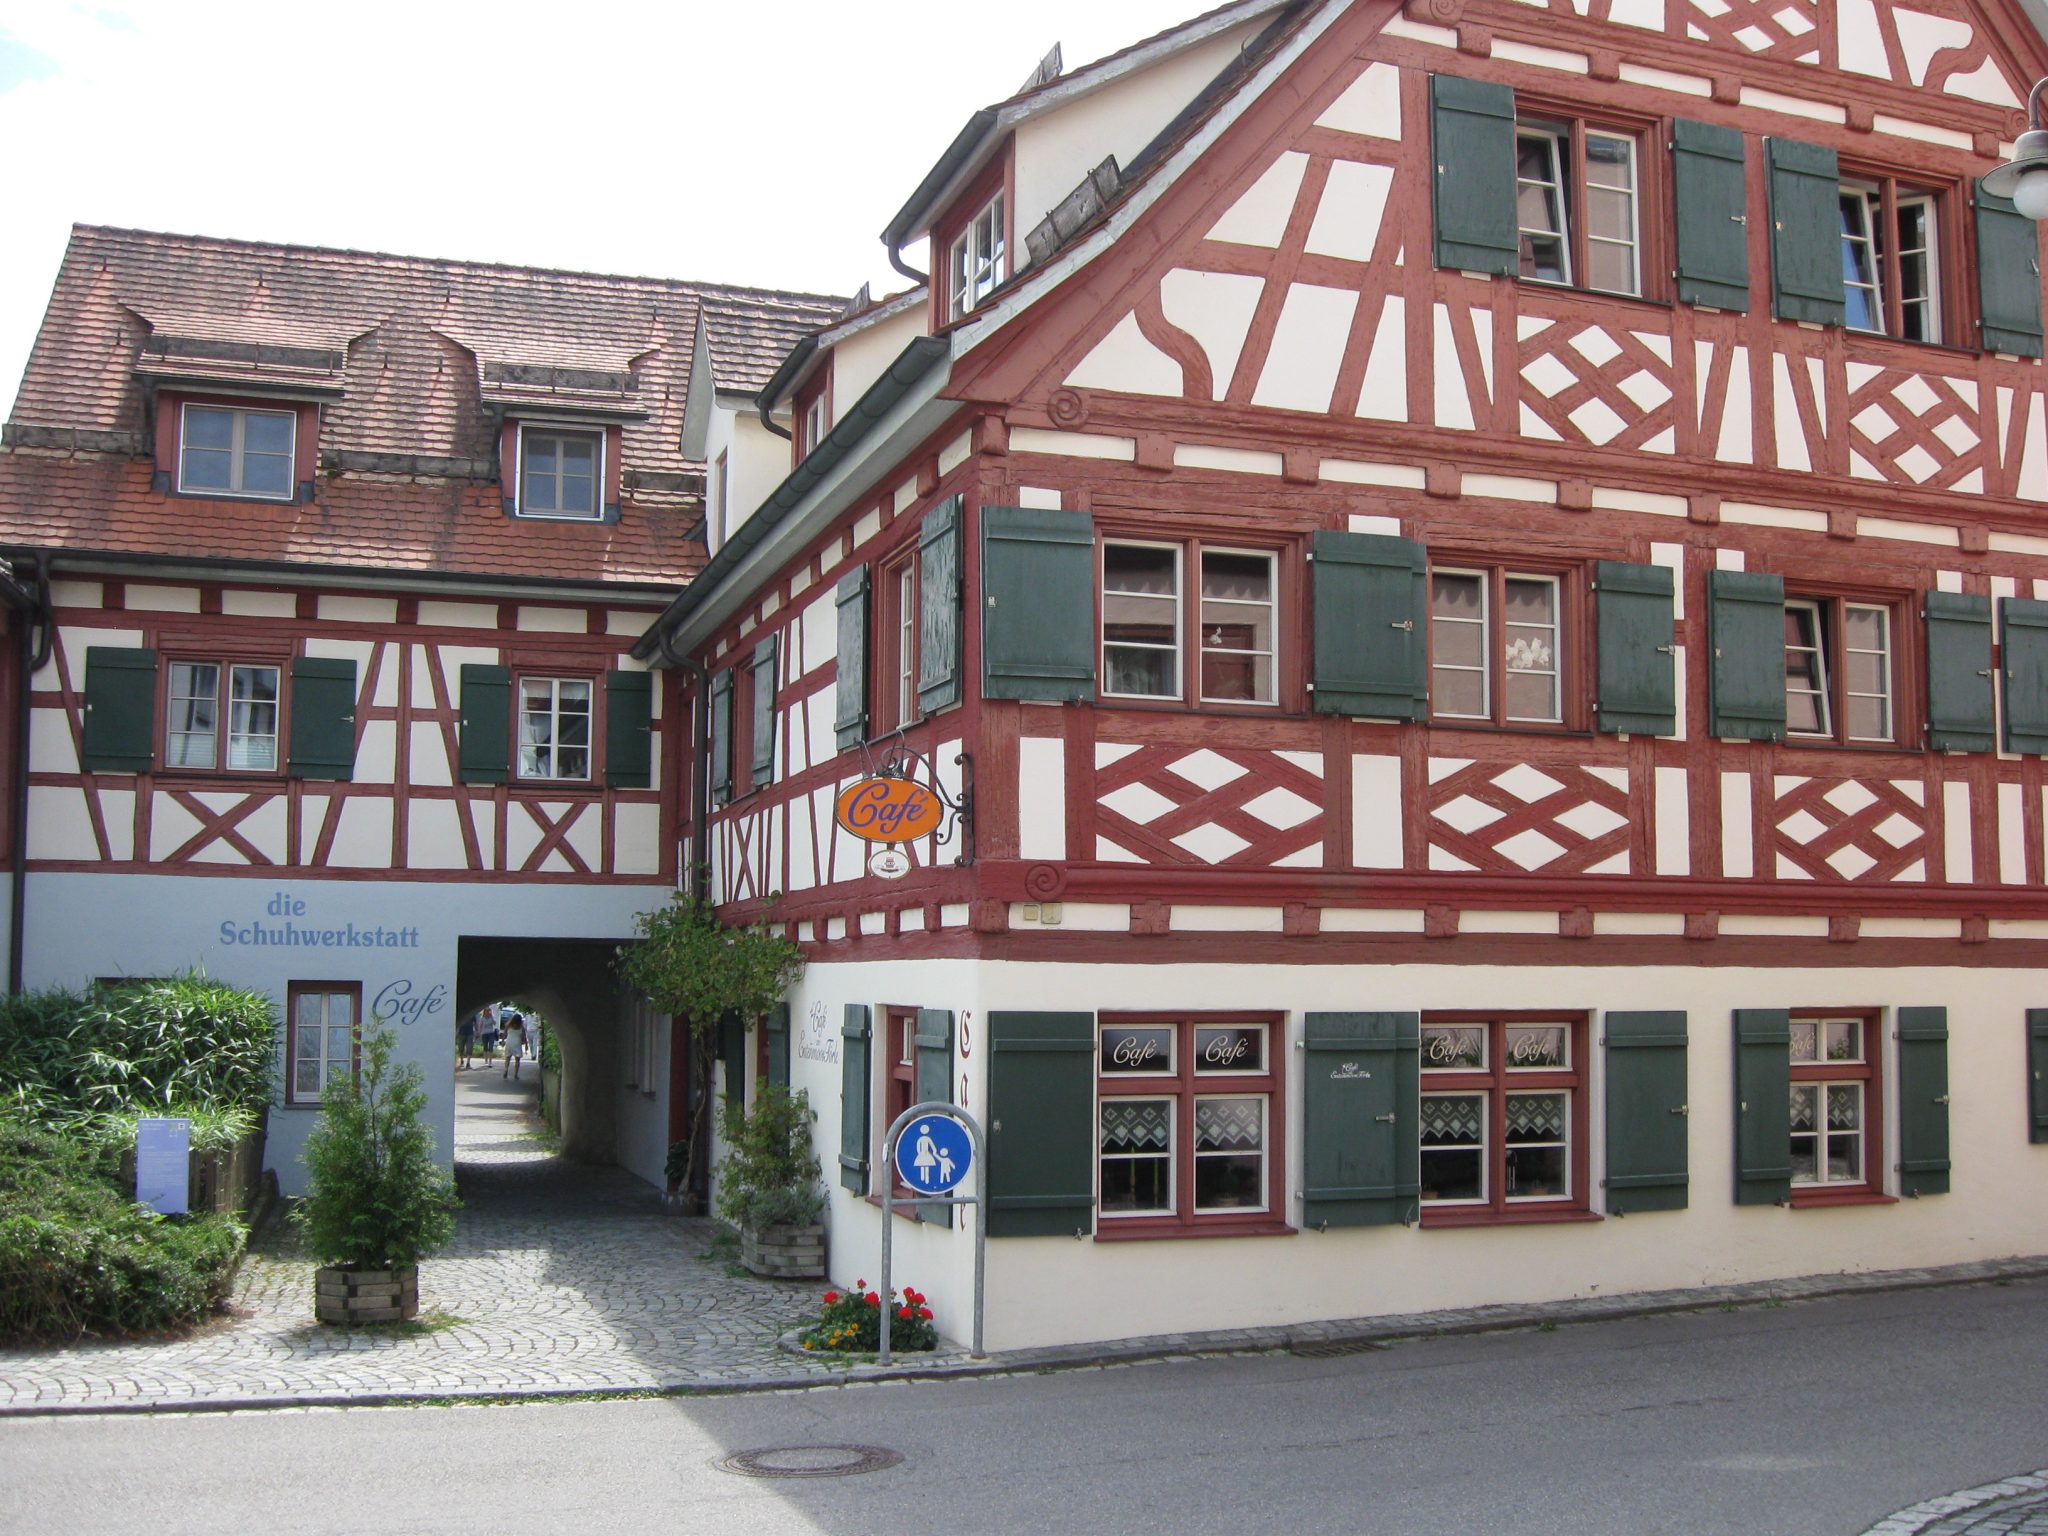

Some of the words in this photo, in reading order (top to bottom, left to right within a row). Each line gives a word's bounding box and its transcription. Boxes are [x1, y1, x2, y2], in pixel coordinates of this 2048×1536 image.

[848, 783, 928, 834] Café
[267, 892, 306, 916] die
[220, 921, 419, 948] Schuhwerkstatt
[372, 979, 448, 1026] Café
[1113, 1036, 1157, 1067] Café
[1205, 1035, 1249, 1065] Café
